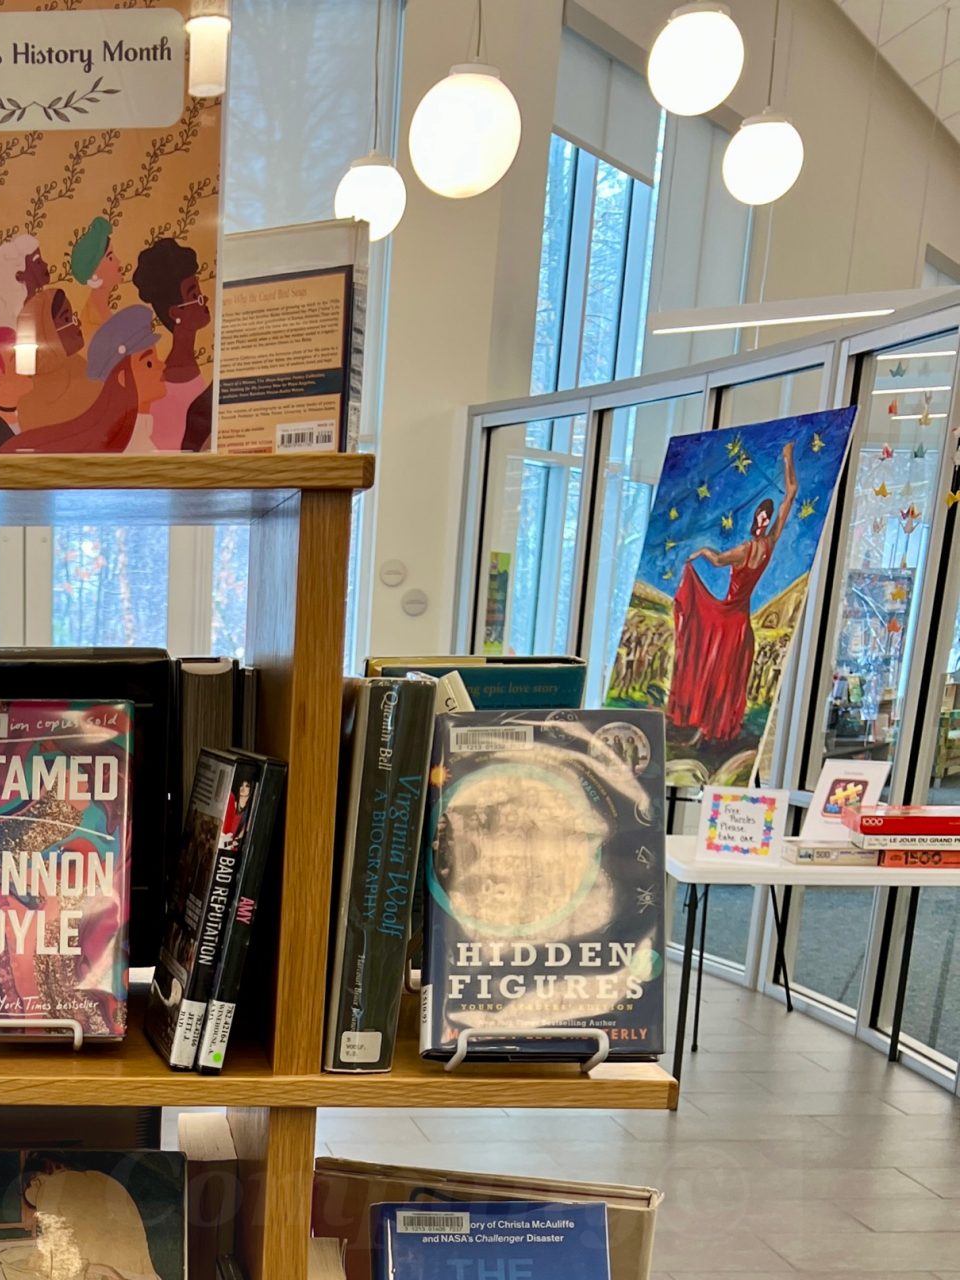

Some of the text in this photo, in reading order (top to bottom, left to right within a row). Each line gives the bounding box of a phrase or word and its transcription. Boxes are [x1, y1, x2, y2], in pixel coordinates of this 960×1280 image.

[13, 41, 95, 73] History
[102, 35, 172, 62] Month
[483, 683, 560, 697] epic love story
[87, 714, 117, 727] sold
[379, 747, 392, 770] Bell
[862, 818, 884, 826] 1000
[889, 836, 952, 844] LE JOUR DU GRAND
[815, 850, 831, 859] 500
[198, 854, 235, 966] BAD REPUTATION
[236, 896, 255, 924] AMY
[456, 942, 636, 967] HIDDEN
[448, 974, 644, 1000] FIGURES
[589, 1019, 616, 1027] Author
[471, 1222, 485, 1231] ory
[487, 1220, 496, 1229] of
[498, 1220, 530, 1229] Christa
[532, 1220, 575, 1229] McAuliffe
[422, 1234, 564, 1246] and NASA's Challenger Disaster
